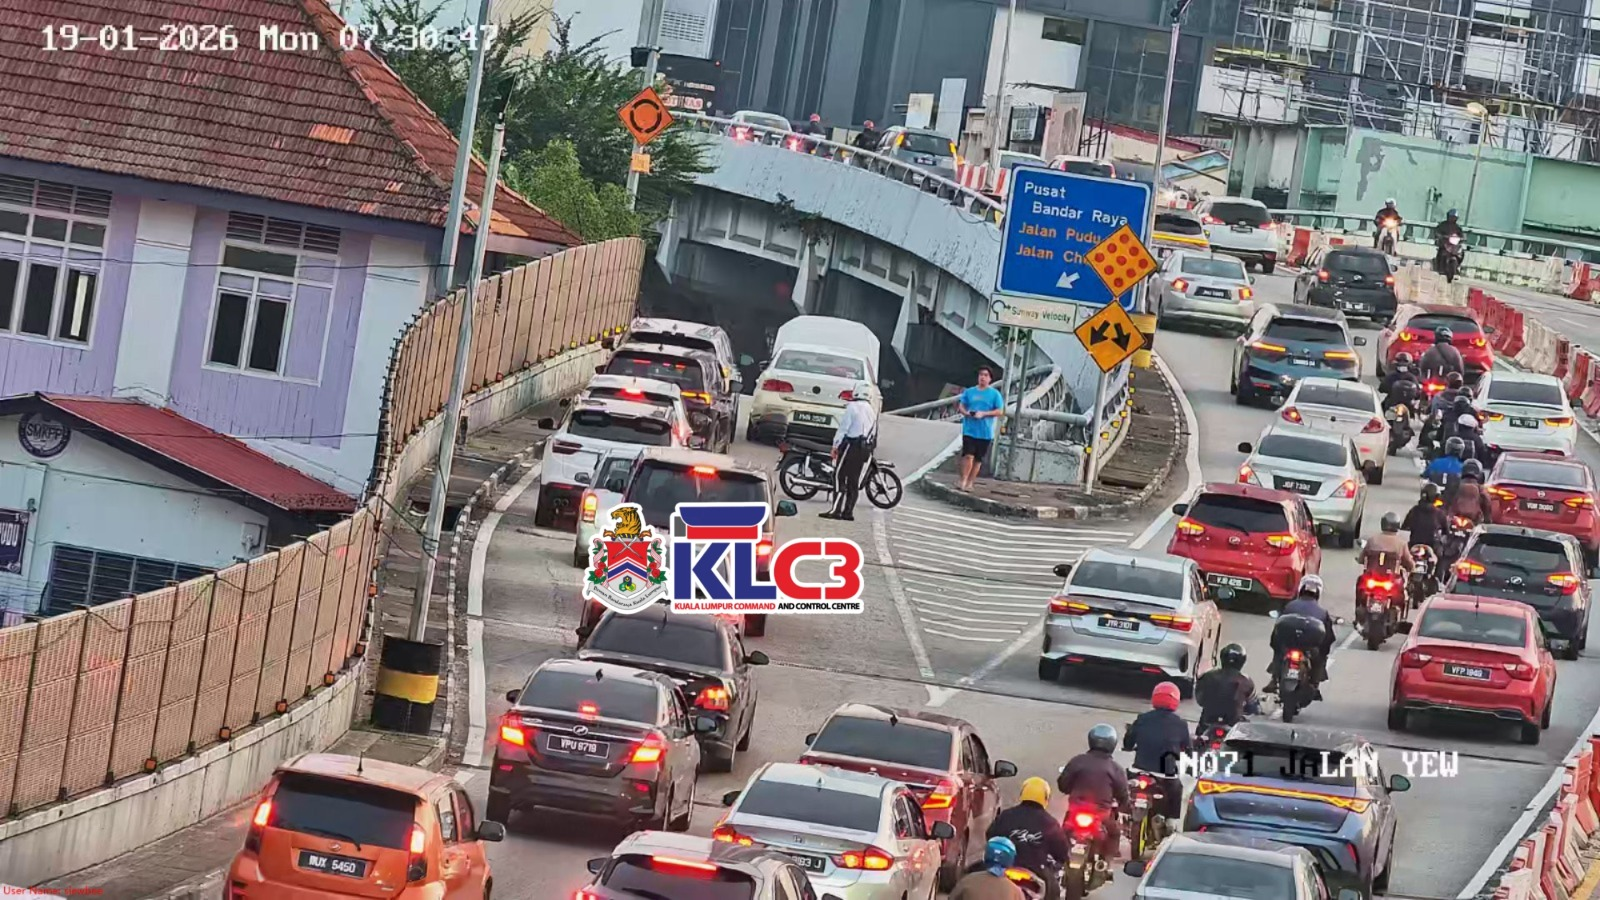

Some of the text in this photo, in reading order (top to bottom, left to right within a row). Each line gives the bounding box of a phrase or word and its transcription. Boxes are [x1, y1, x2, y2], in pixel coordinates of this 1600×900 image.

[1024, 181, 1067, 199] Pusat
[1032, 200, 1128, 228] Bandar Raya
[1018, 221, 1101, 244] Jalan Pudu
[1016, 243, 1053, 260] Jalan
[560, 738, 577, 749] VPU
[309, 855, 356, 873] WUX 5450
[814, 859, 822, 869] J
